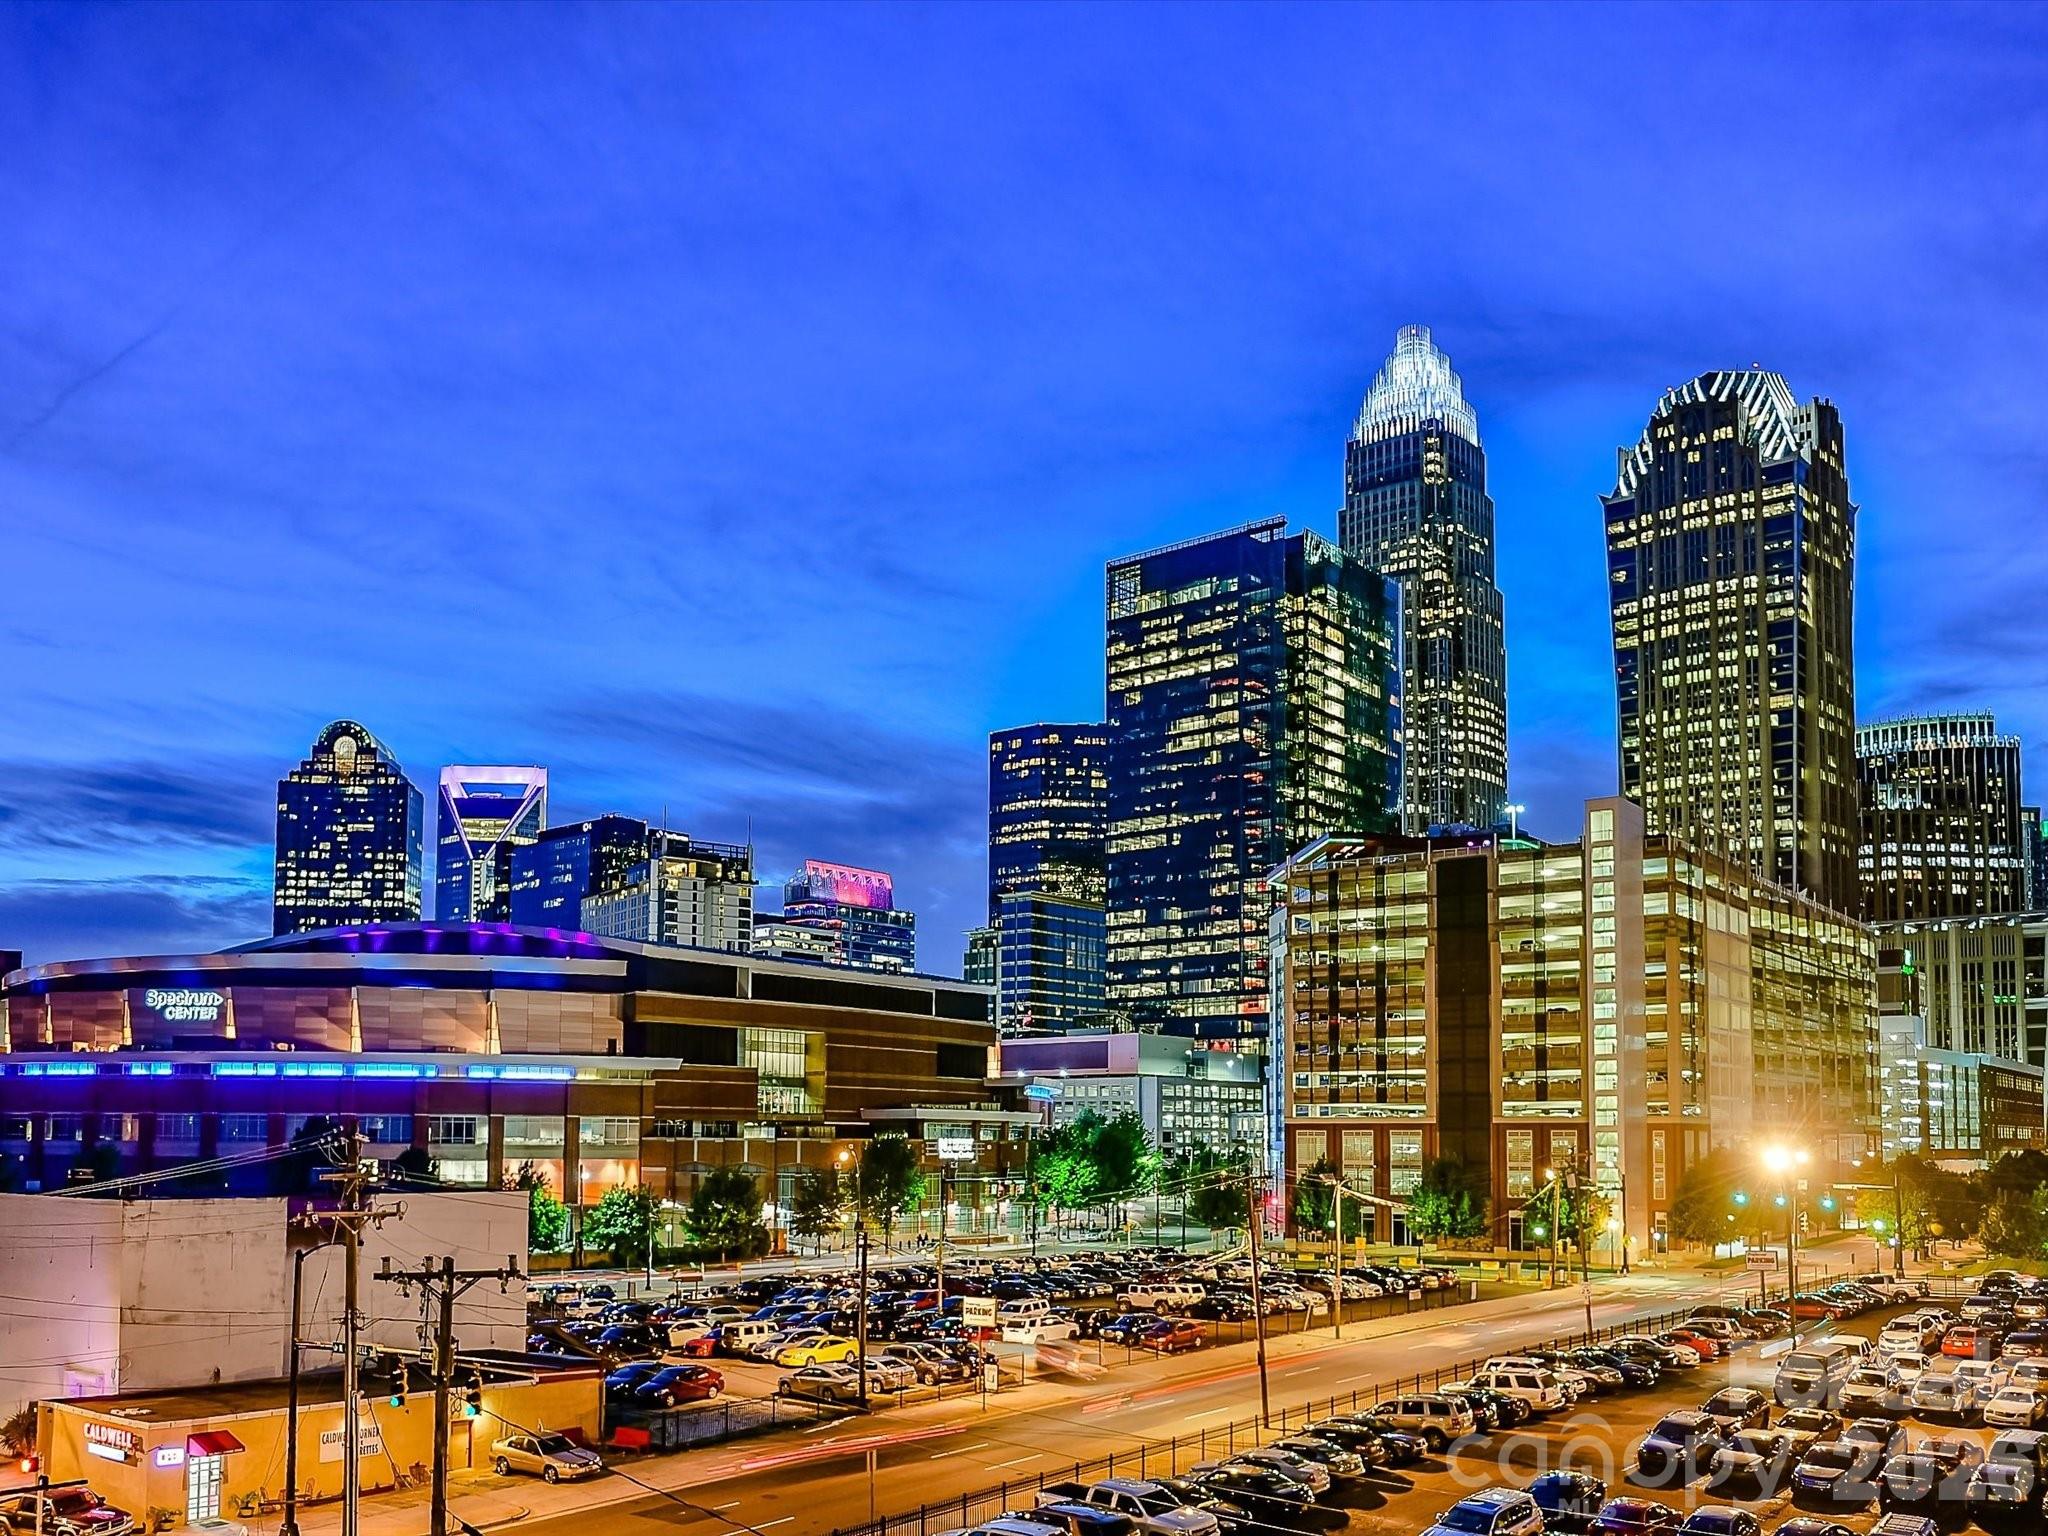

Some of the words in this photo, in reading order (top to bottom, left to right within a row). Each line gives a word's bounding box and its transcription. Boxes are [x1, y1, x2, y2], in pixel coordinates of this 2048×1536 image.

[146, 989, 221, 1010] Spectrum
[165, 1007, 218, 1020] CENTER
[965, 1307, 993, 1317] PARKING
[84, 1423, 133, 1448] CALDWELL
